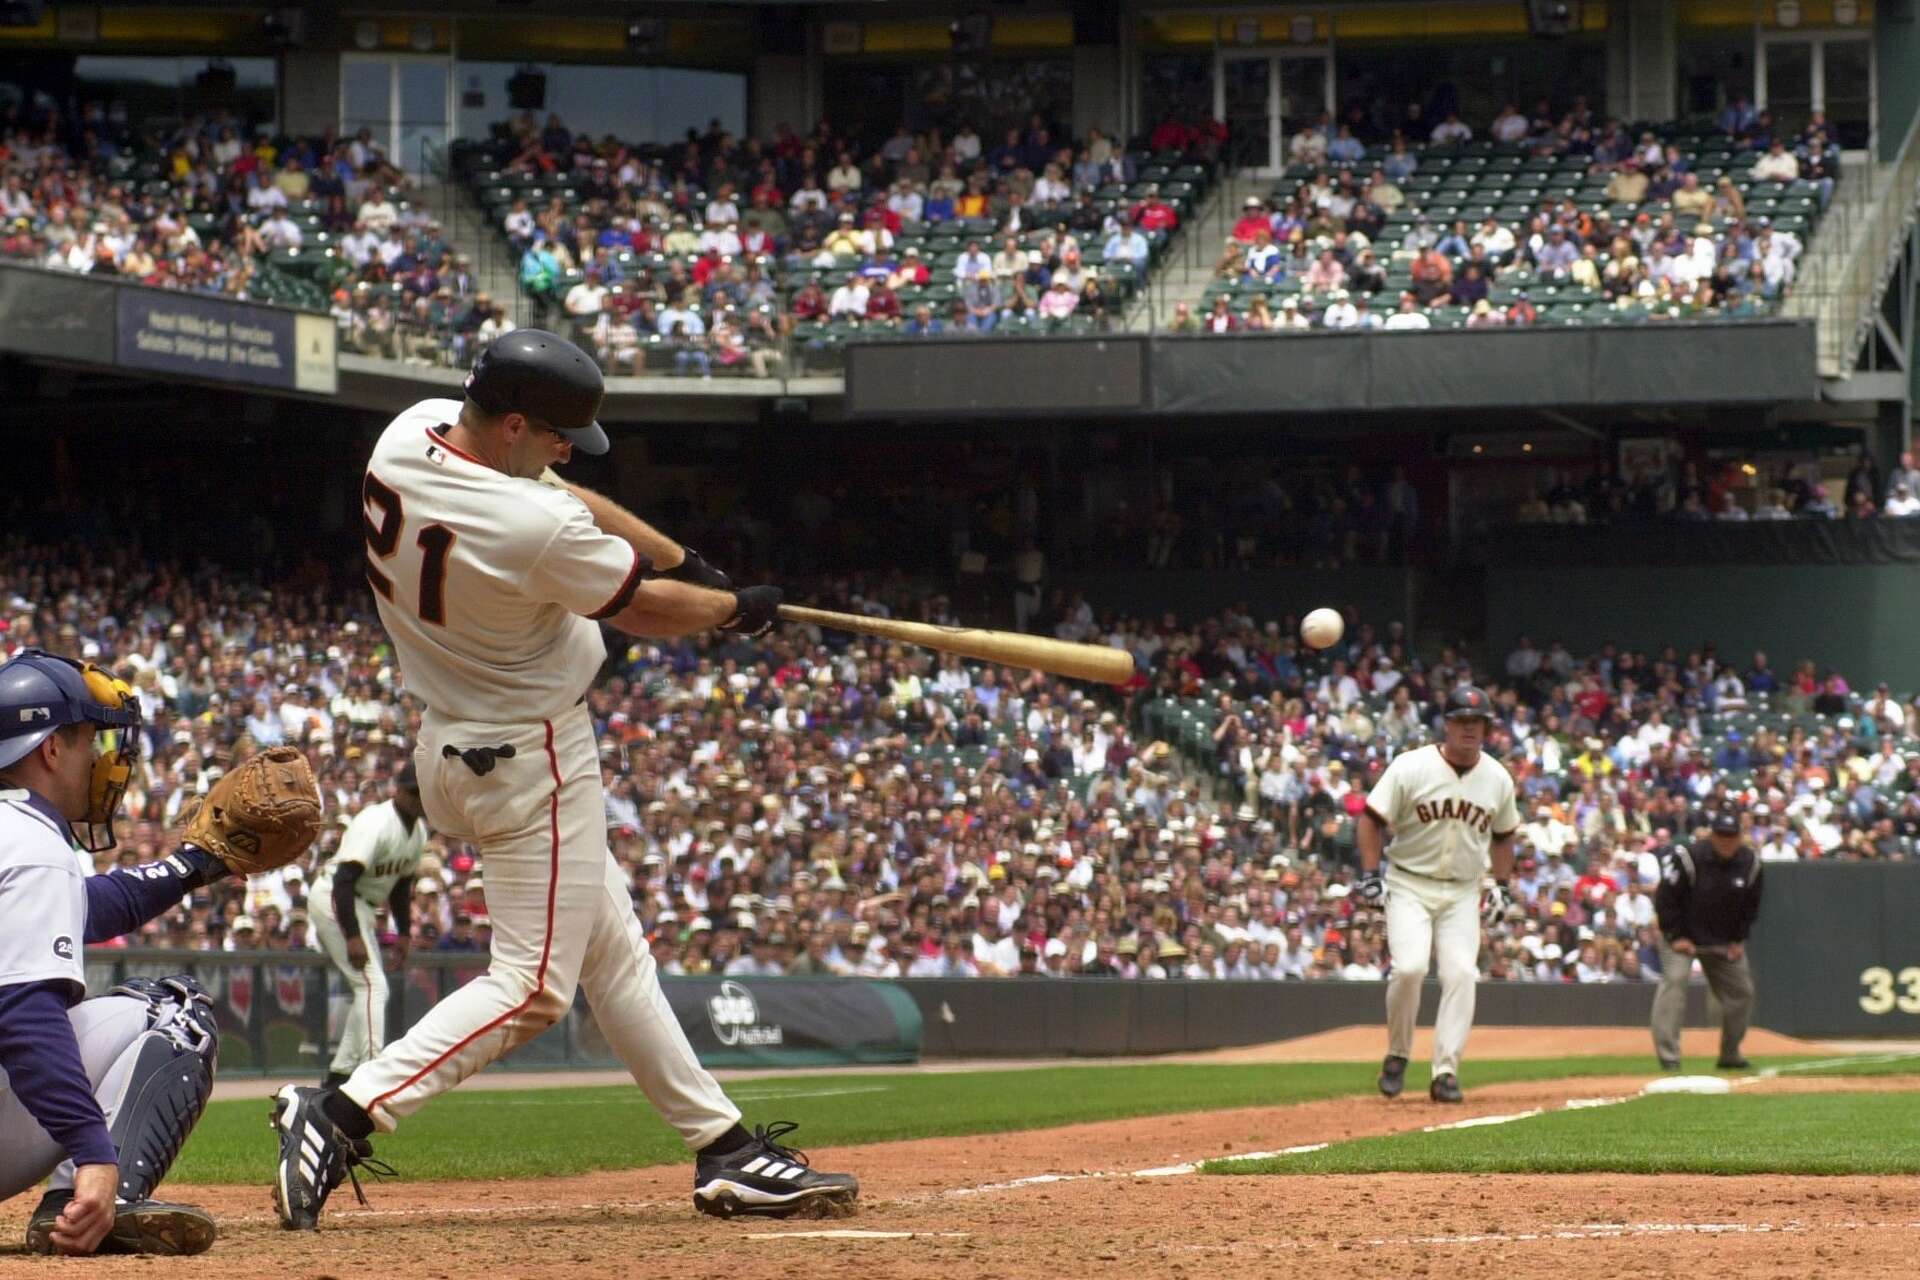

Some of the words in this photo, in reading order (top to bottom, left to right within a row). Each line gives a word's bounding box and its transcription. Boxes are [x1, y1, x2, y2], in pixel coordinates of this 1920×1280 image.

[363, 470, 457, 627] 21
[1416, 798, 1493, 833] GIANTS
[1859, 966, 1920, 1015] 33
